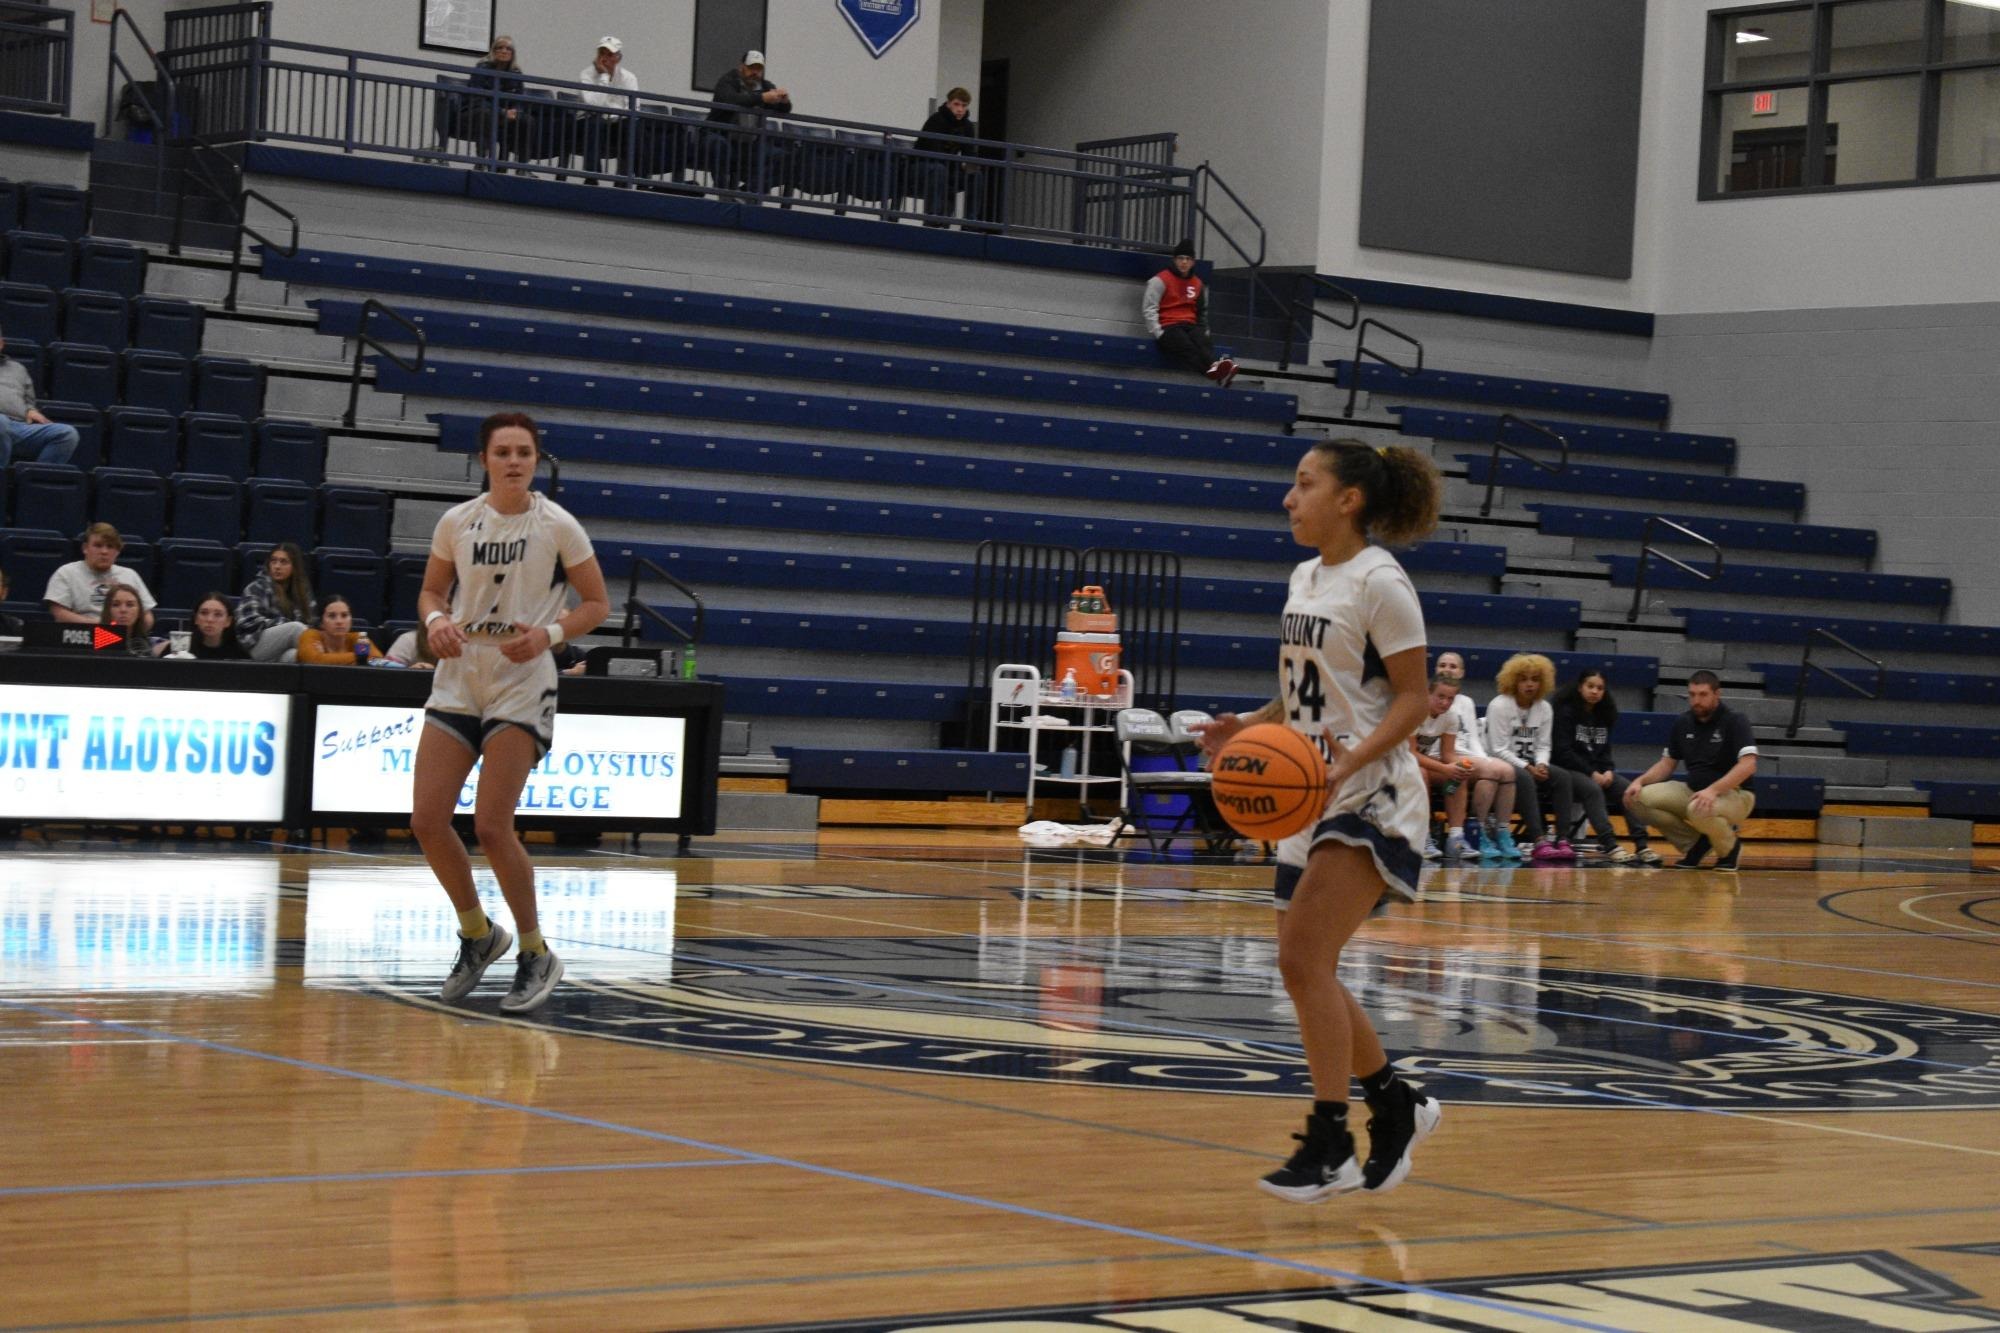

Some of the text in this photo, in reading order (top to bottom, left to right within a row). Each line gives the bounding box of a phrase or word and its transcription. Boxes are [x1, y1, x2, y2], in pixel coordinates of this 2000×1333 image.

[1754, 93, 1772, 112] EXIT
[1186, 286, 1196, 298] S
[1281, 613, 1331, 649] OUNT
[82, 715, 276, 776] ALOYSIUS
[322, 714, 414, 759] Support
[531, 751, 674, 777] LOYSIUS
[455, 783, 610, 809] CLEGE
